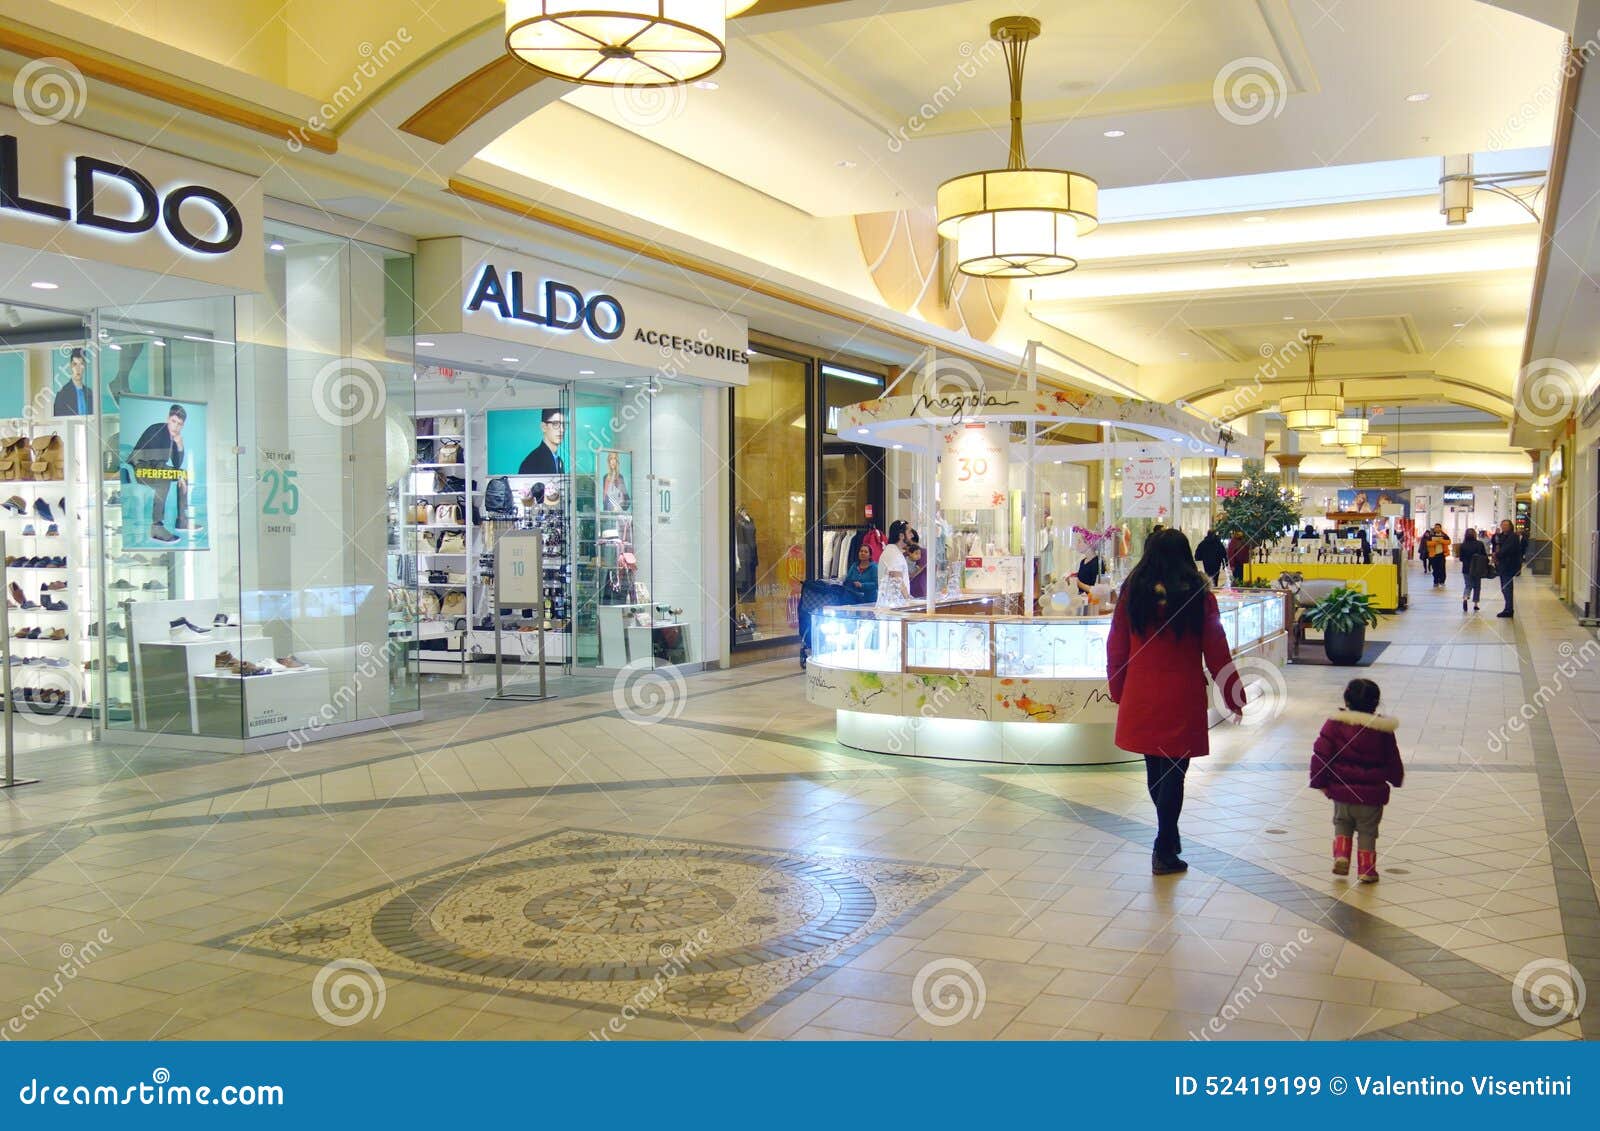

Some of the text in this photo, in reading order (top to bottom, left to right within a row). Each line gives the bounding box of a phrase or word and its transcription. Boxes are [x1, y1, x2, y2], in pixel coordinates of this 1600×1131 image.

[0, 134, 243, 254] LDO
[466, 264, 749, 364] ALDO ACCESSORIES
[910, 384, 1020, 426] Magnolia
[136, 467, 194, 480] #PERFECTPA
[958, 457, 988, 482] 30
[659, 489, 671, 513] 10
[1134, 482, 1156, 499] 30
[512, 560, 525, 577] 10
